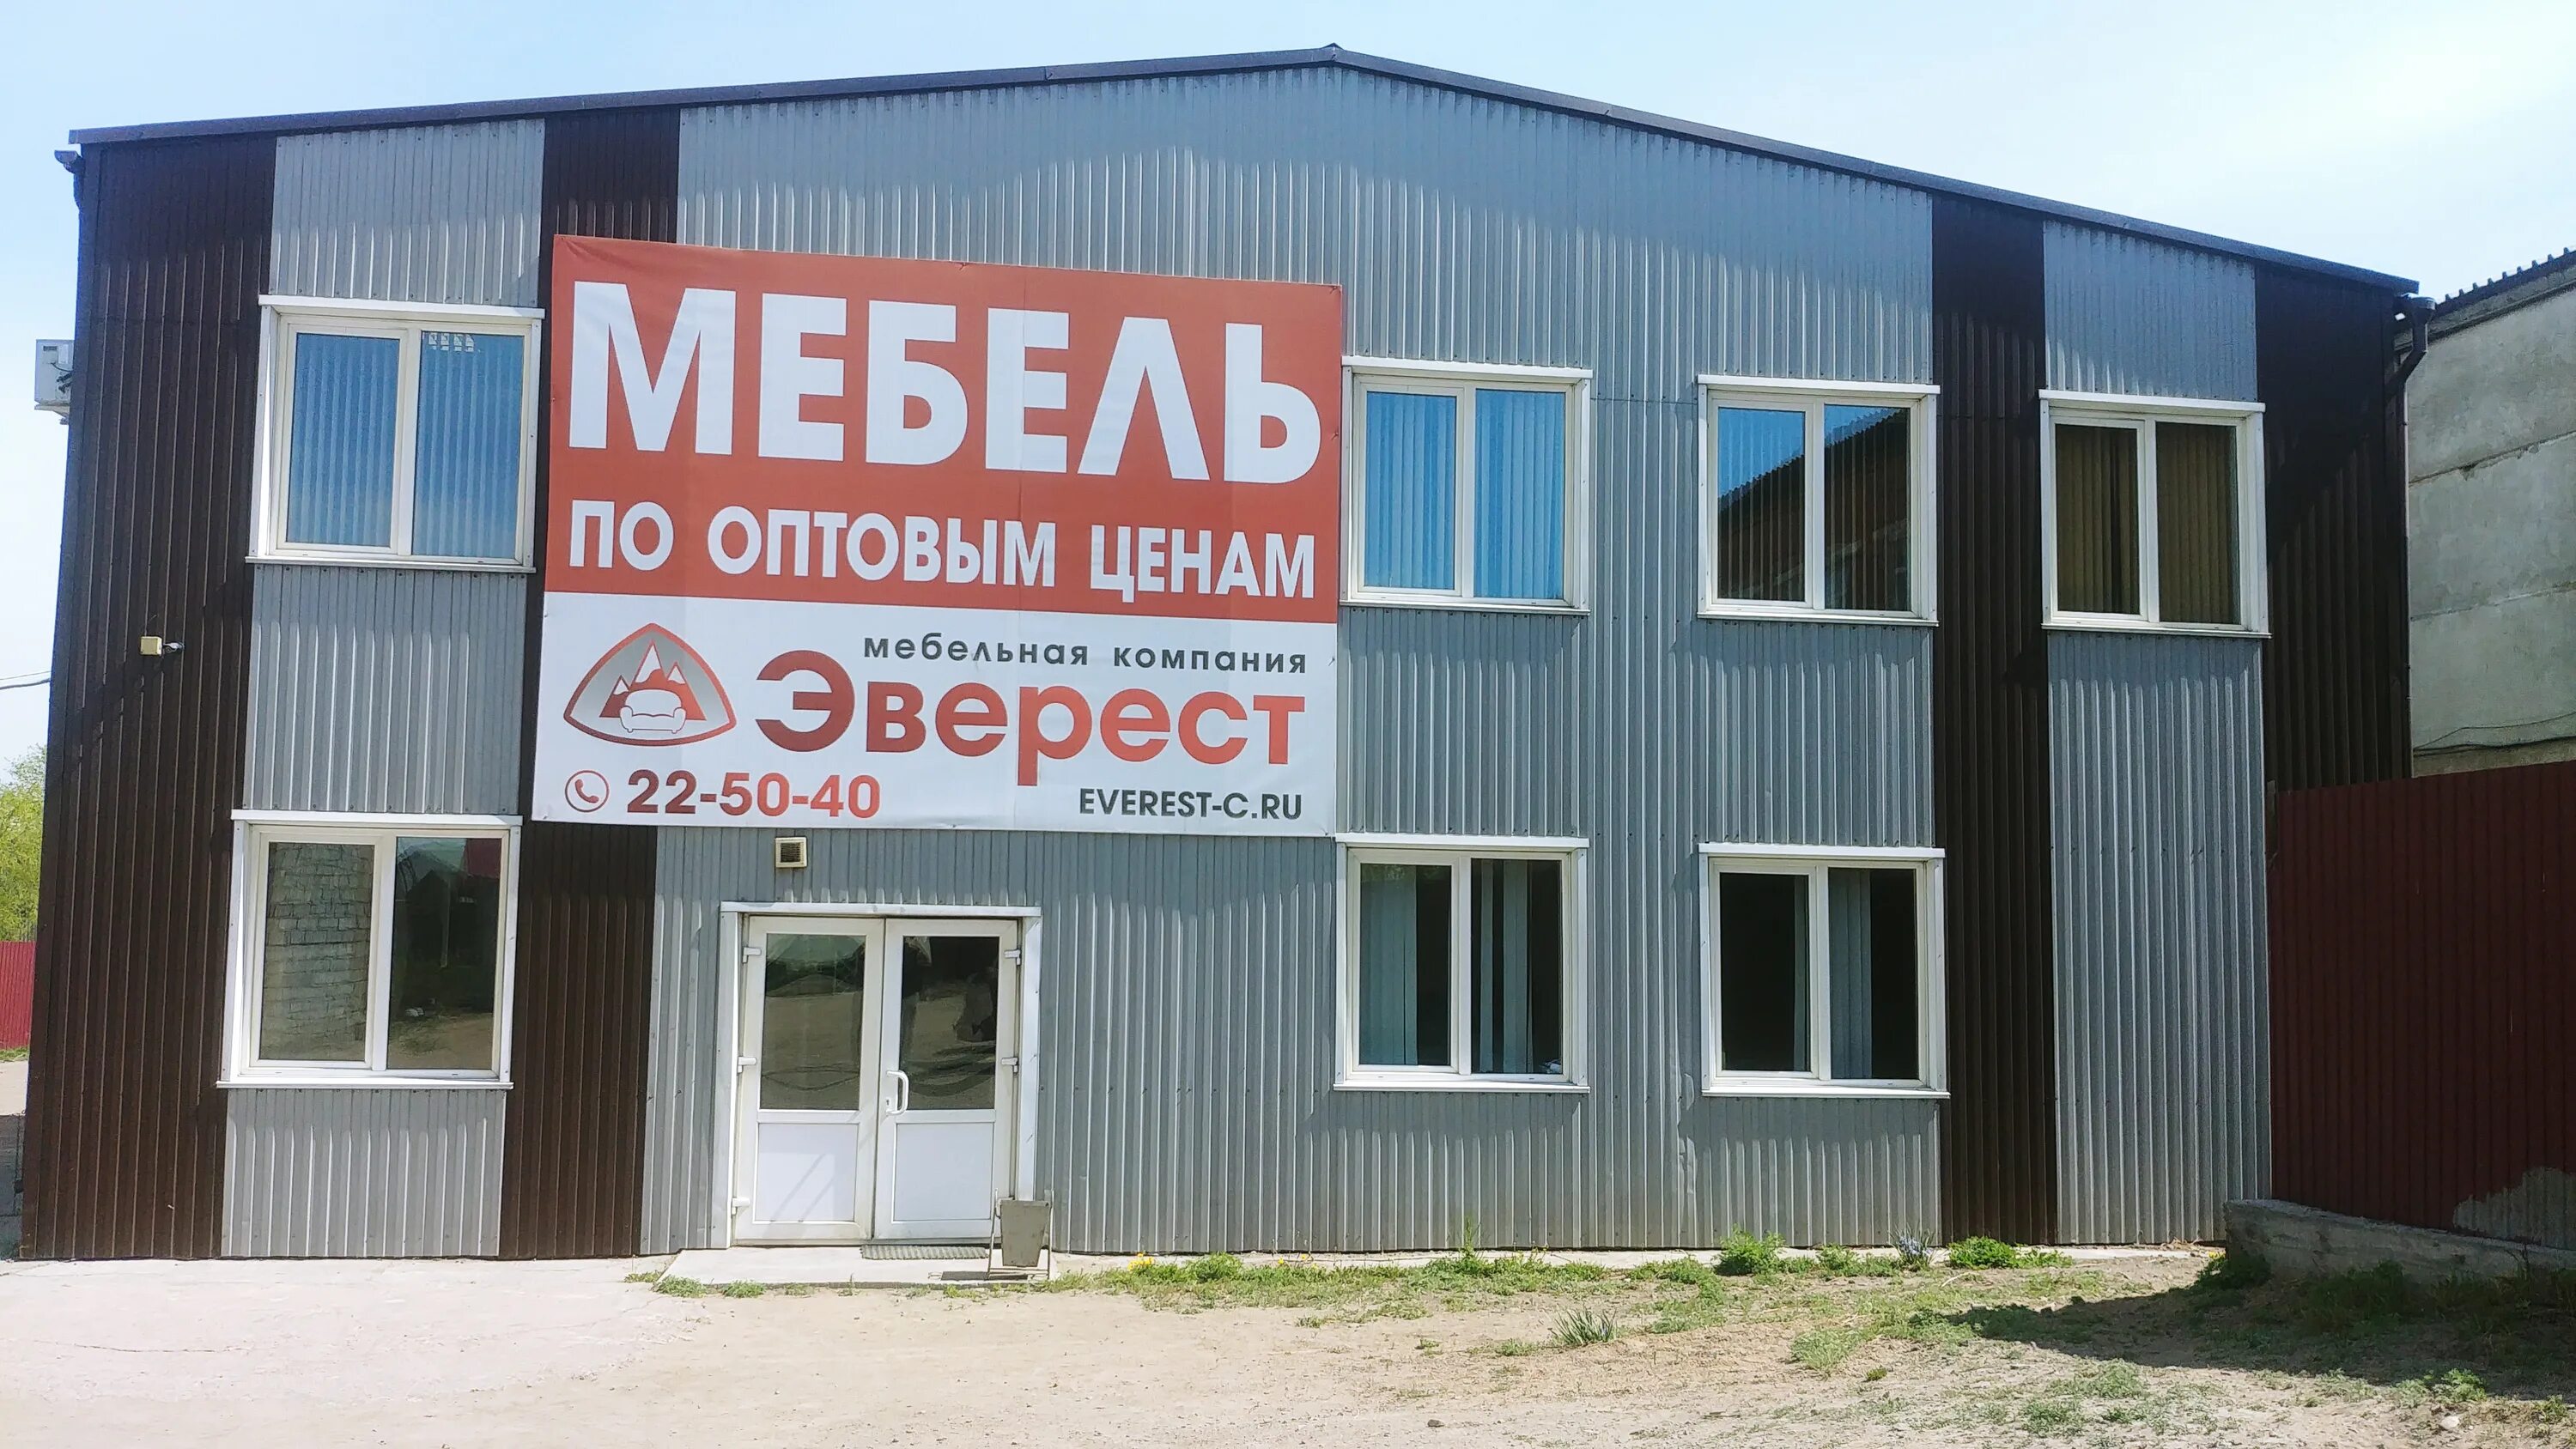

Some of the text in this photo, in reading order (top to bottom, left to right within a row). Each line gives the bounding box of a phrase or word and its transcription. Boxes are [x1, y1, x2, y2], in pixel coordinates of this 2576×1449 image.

[568, 280, 1321, 485] МЕБЕЛЬ
[568, 500, 1316, 604] ПО ОПТОВЫМ ЦЕНАМ
[863, 632, 1308, 675] мебельная компания
[755, 649, 1305, 786] Эверест
[627, 770, 882, 819] 22-50-40
[1079, 787, 1303, 821] EVEREST-C.RU
